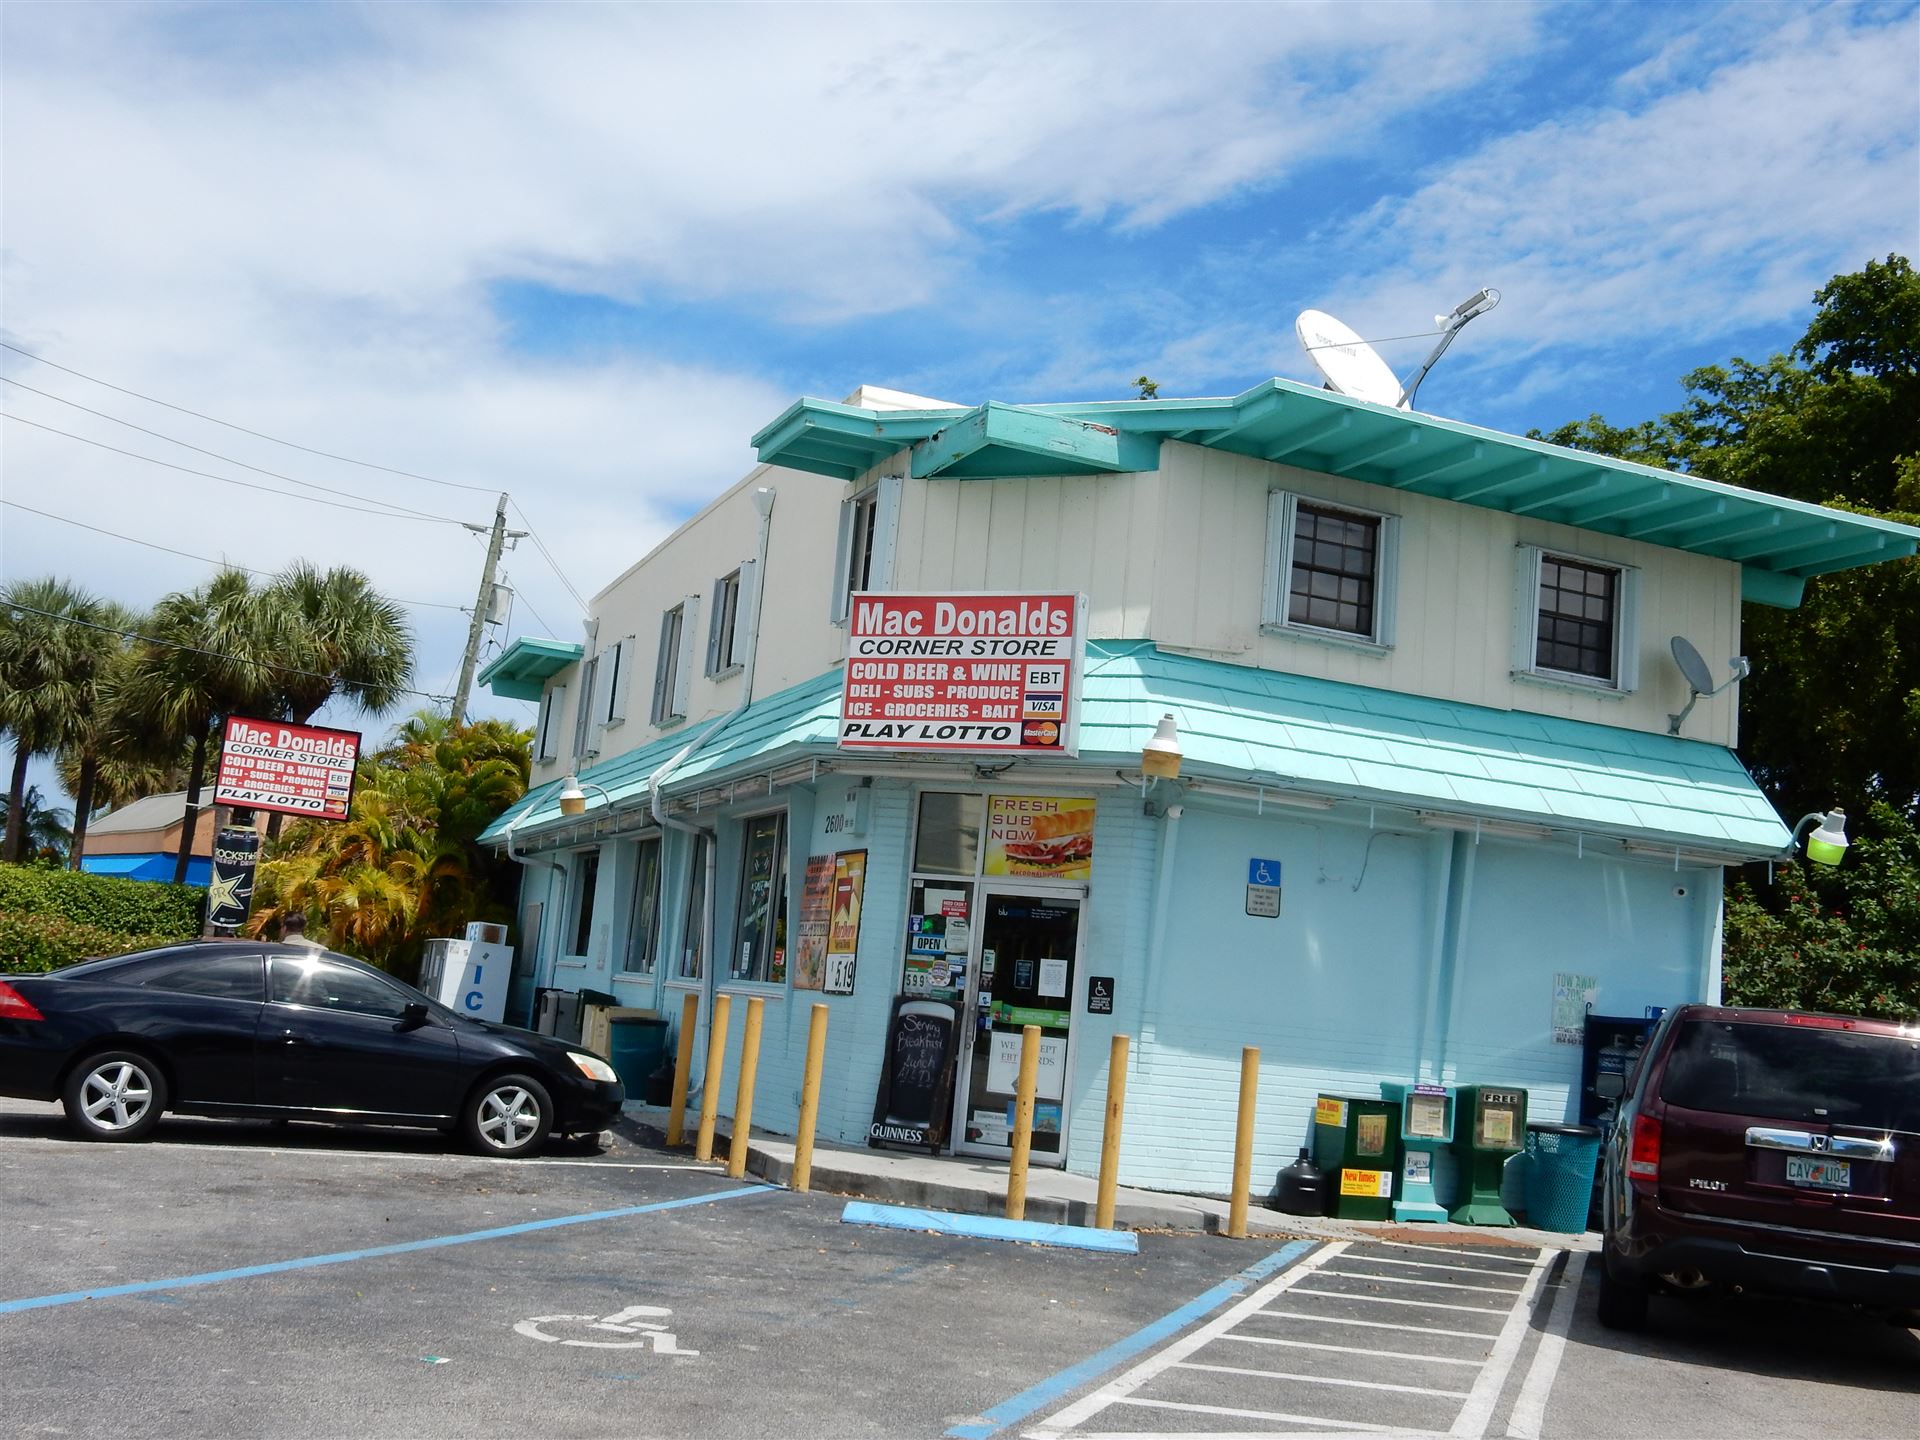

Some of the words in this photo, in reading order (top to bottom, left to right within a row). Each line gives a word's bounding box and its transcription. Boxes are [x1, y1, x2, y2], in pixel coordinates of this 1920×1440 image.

[857, 602, 923, 636] Mac
[934, 602, 1068, 636] Donalds
[859, 640, 964, 656] CORNER
[970, 640, 1058, 656] STORE
[851, 662, 899, 680] COLD
[902, 663, 949, 680] BEER
[952, 666, 966, 680] &
[971, 664, 1022, 681] WINE
[1030, 671, 1061, 684] EBT
[849, 684, 881, 698] DELI
[892, 684, 935, 698] SUBS
[946, 685, 1020, 700] PRODUCE
[848, 702, 872, 716] ICE
[884, 702, 970, 718] GROCERIES
[981, 704, 1018, 719] BAIT
[1031, 701, 1056, 712] VISA
[842, 722, 915, 738] PLAY
[919, 724, 1012, 740] LOTTO
[230, 723, 272, 746] Mac
[277, 729, 356, 758] Donalds
[231, 744, 294, 760] CORNER
[298, 754, 348, 768] STORE
[224, 755, 255, 768] COLD
[256, 760, 284, 772] BEER
[286, 765, 294, 774] &
[298, 765, 327, 779] WINE
[223, 766, 243, 776] DELI
[250, 770, 275, 782] SUBS
[282, 775, 326, 788] PRODUCE
[330, 774, 348, 783] EBT
[244, 780, 295, 794] GROCERIES
[302, 788, 324, 798] BAIT
[220, 788, 264, 801] PLAY
[267, 795, 322, 809] LOTTO
[994, 800, 1058, 812] FRESH
[824, 814, 844, 834] 2600
[992, 814, 1032, 826] SUB
[991, 830, 1034, 840] NOW
[998, 906, 1008, 916] blu
[918, 938, 941, 950] OPEN
[1566, 988, 1585, 1002] ZONE
[904, 1014, 941, 1038] Serving
[897, 1031, 944, 1052] Breakfast
[1000, 1040, 1016, 1050] WE
[904, 1054, 936, 1069] Lunch
[1001, 1053, 1017, 1062] EBT
[1484, 1093, 1518, 1104] FREE
[870, 1122, 924, 1142] GUINNESS
[1344, 1170, 1357, 1182] New
[1358, 1172, 1376, 1183] Times
[1788, 1162, 1810, 1178] CAV
[1690, 1178, 1729, 1191] PILOT
